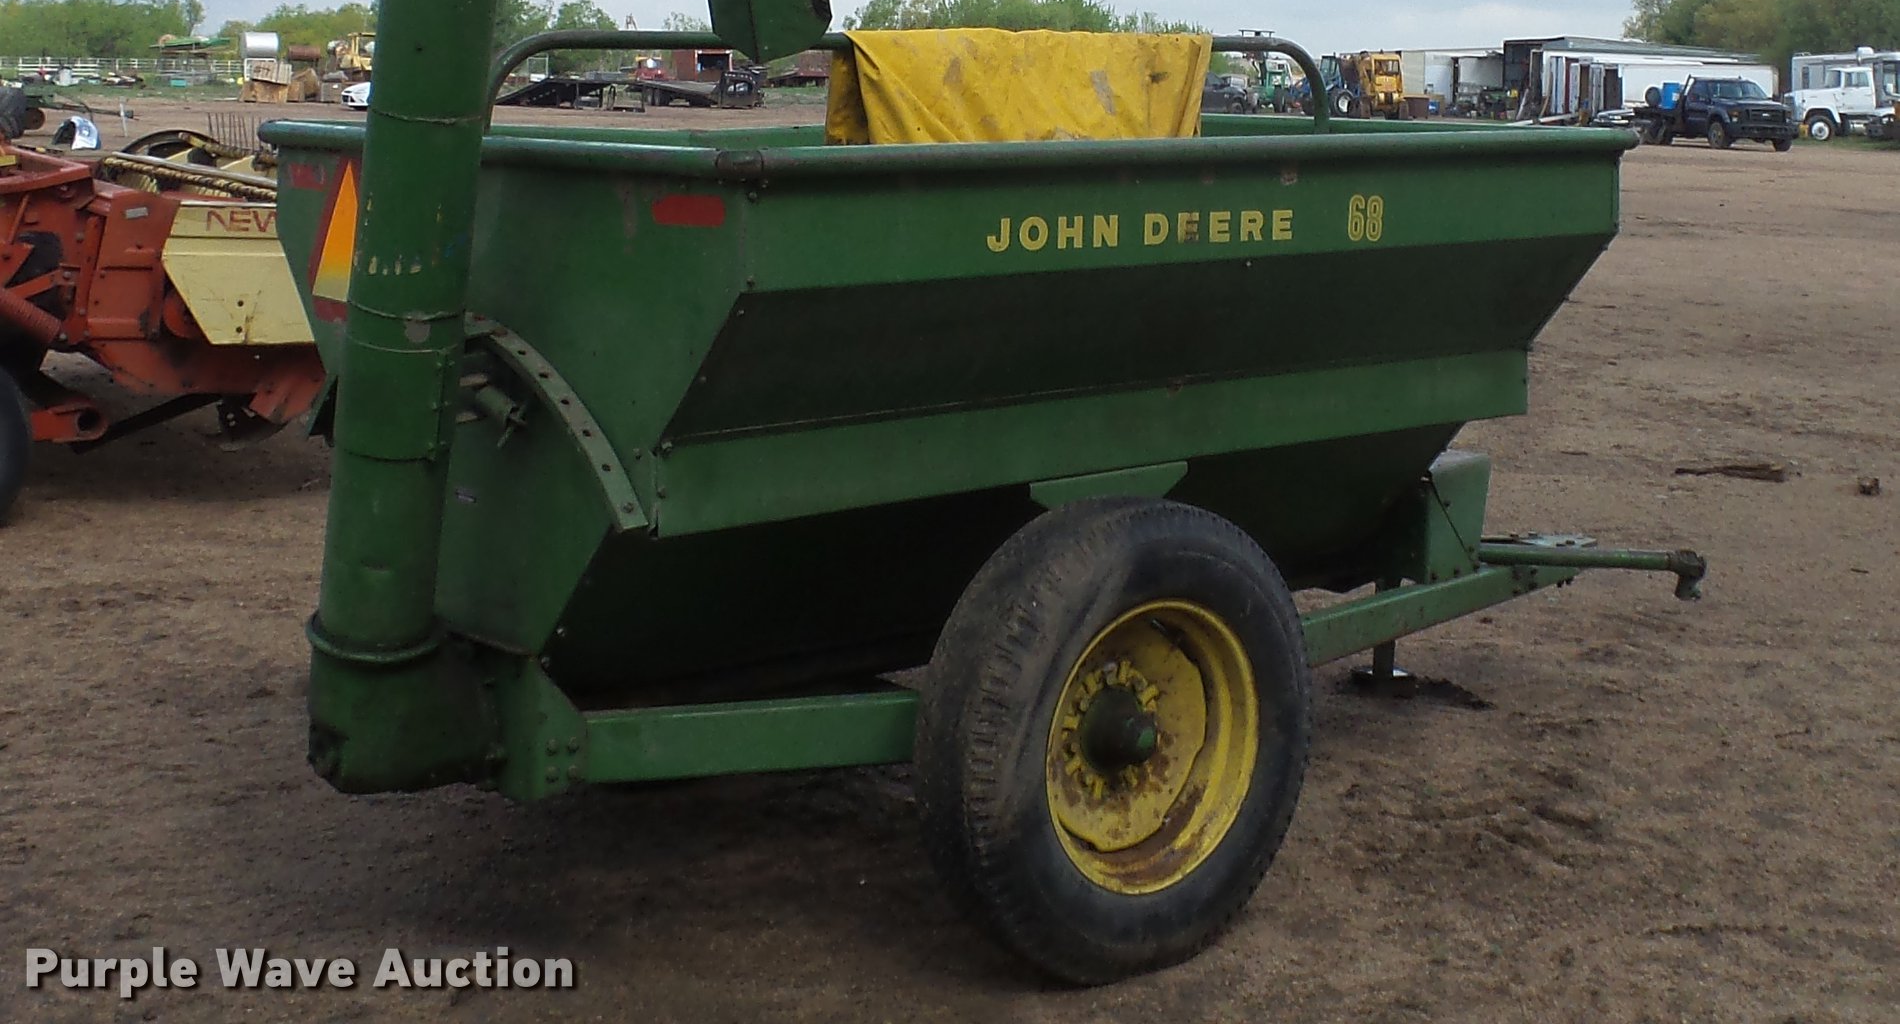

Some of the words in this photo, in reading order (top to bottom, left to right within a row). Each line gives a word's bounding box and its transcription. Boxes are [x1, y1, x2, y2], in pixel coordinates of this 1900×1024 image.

[986, 214, 1119, 252] JOHN
[1144, 209, 1293, 245] DEERE
[1348, 194, 1384, 241] 68
